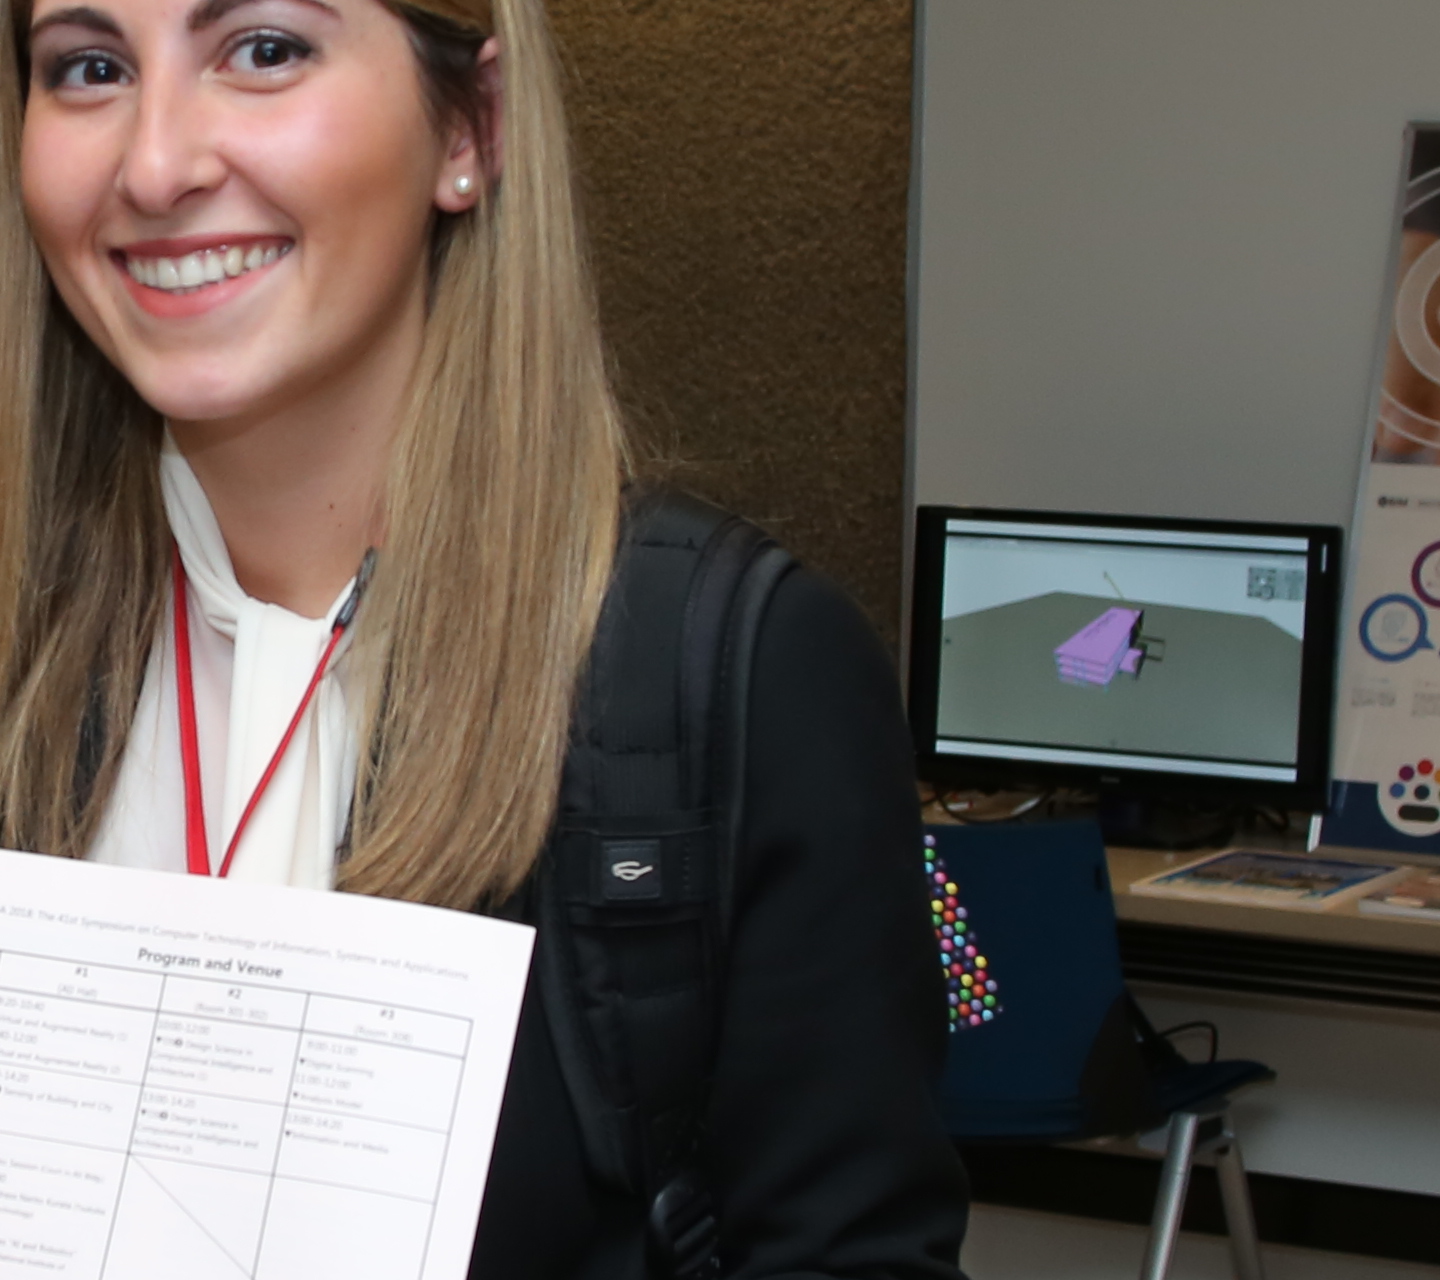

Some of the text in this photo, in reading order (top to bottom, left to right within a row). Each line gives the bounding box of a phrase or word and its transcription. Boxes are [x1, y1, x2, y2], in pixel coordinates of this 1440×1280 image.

[152, 927, 199, 943] Computer
[136, 947, 283, 978] Program and Venue
[74, 966, 89, 977] #1
[226, 987, 242, 999] #2
